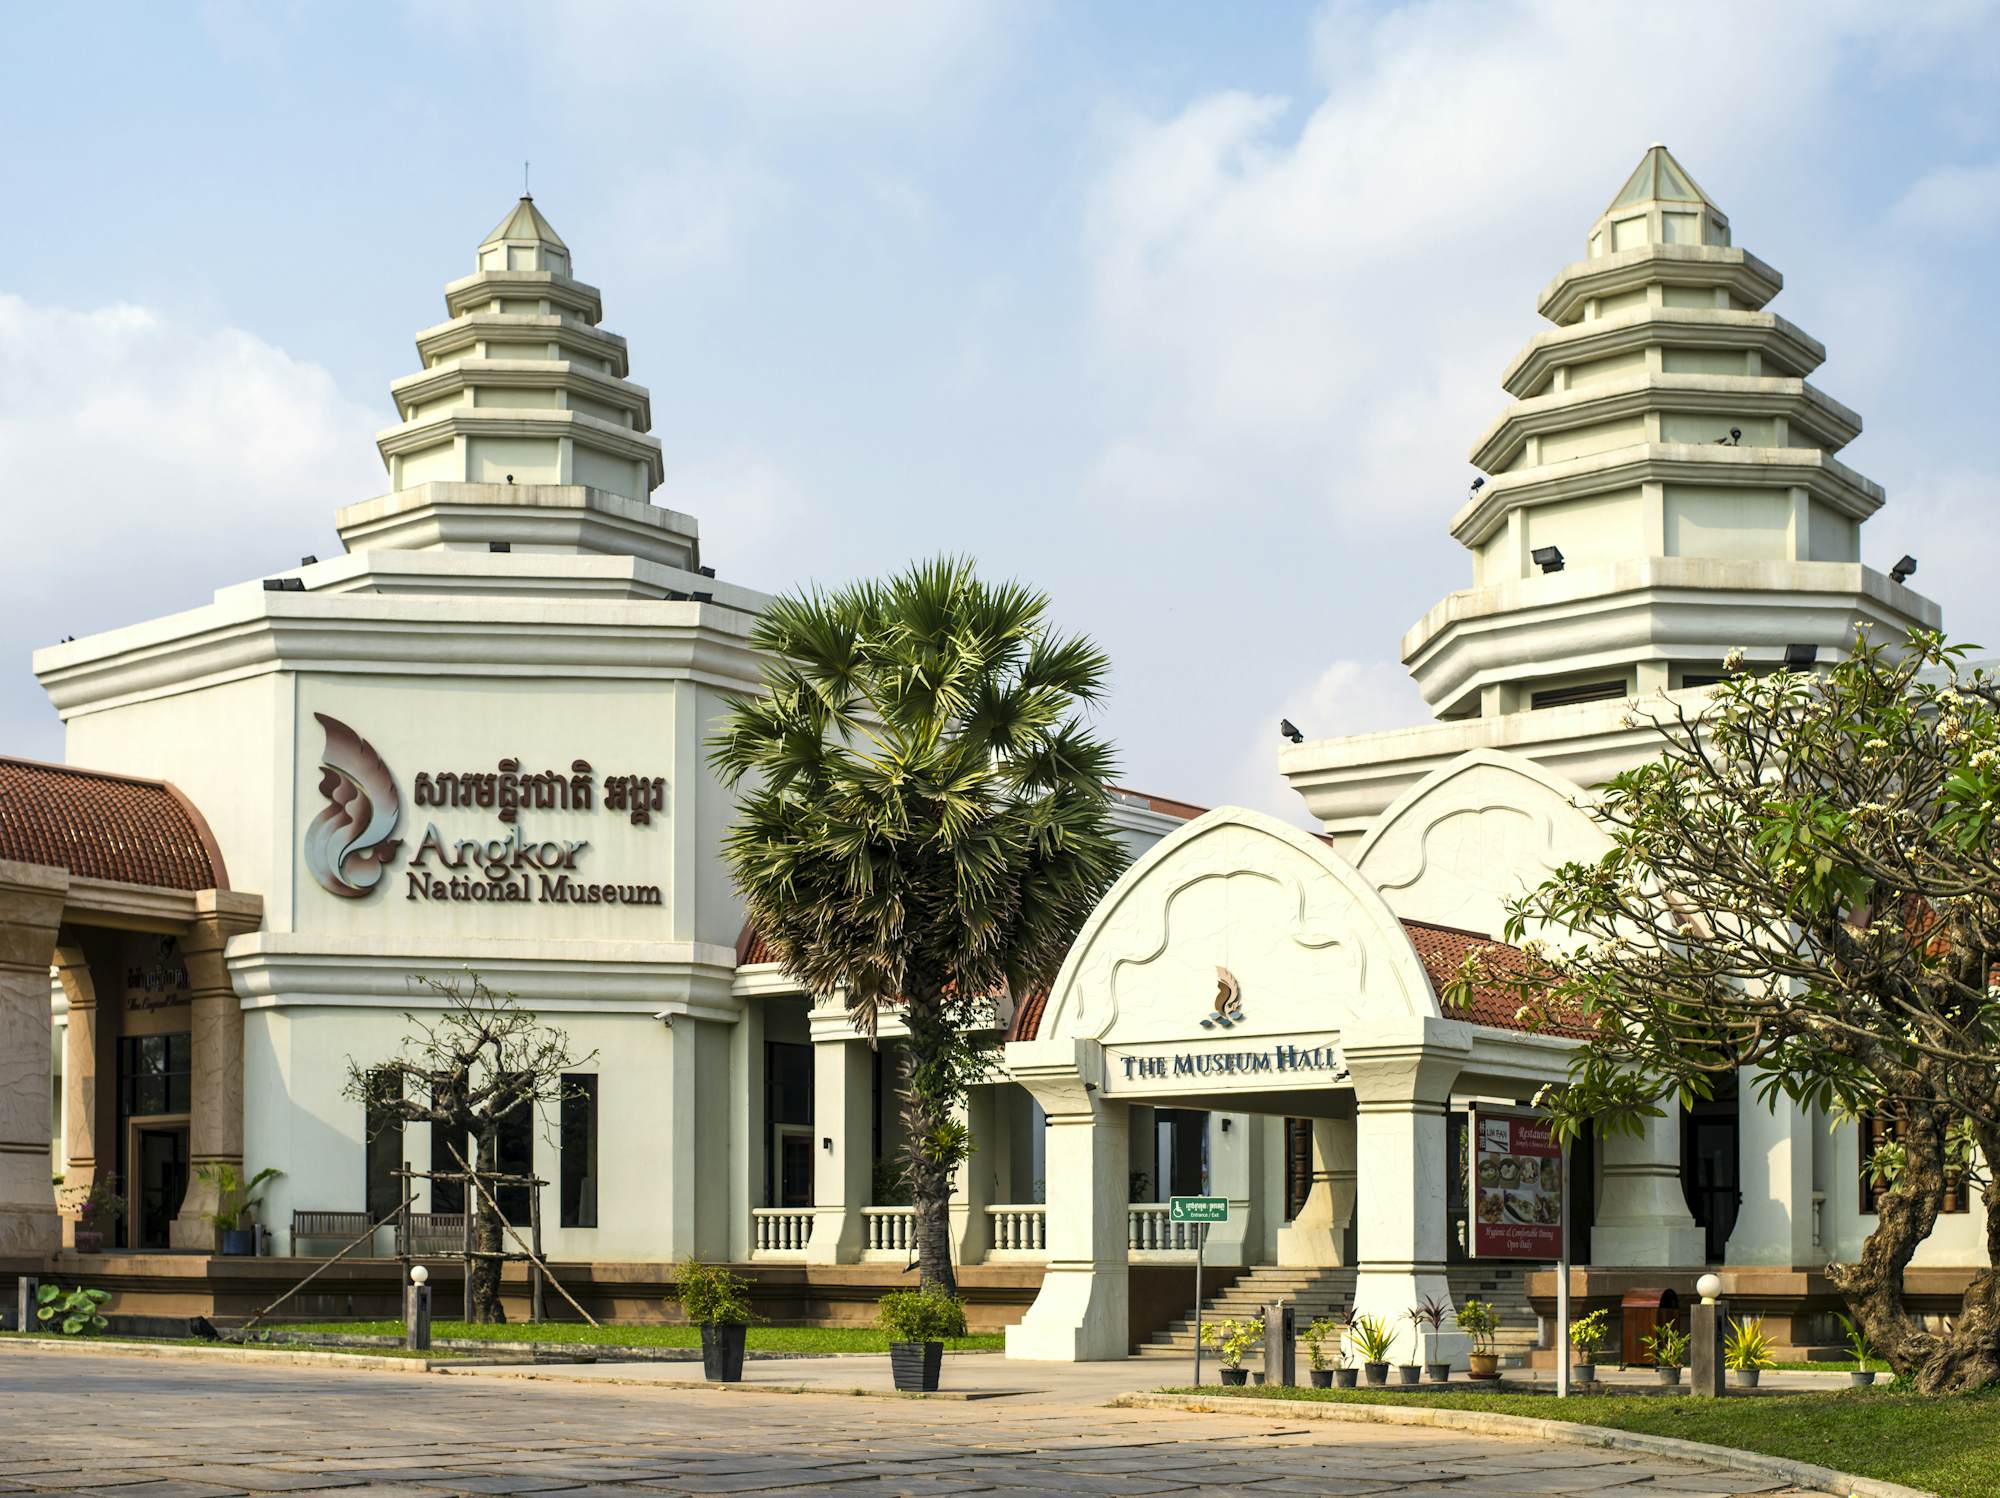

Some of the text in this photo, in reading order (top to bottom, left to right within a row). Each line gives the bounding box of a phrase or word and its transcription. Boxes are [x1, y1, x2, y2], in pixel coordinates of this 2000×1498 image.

[603, 773, 665, 825] អង្គរ
[408, 822, 589, 881] Angkor
[406, 871, 663, 905] National Museum
[1121, 1045, 1338, 1077] THE MUSEUM HALL
